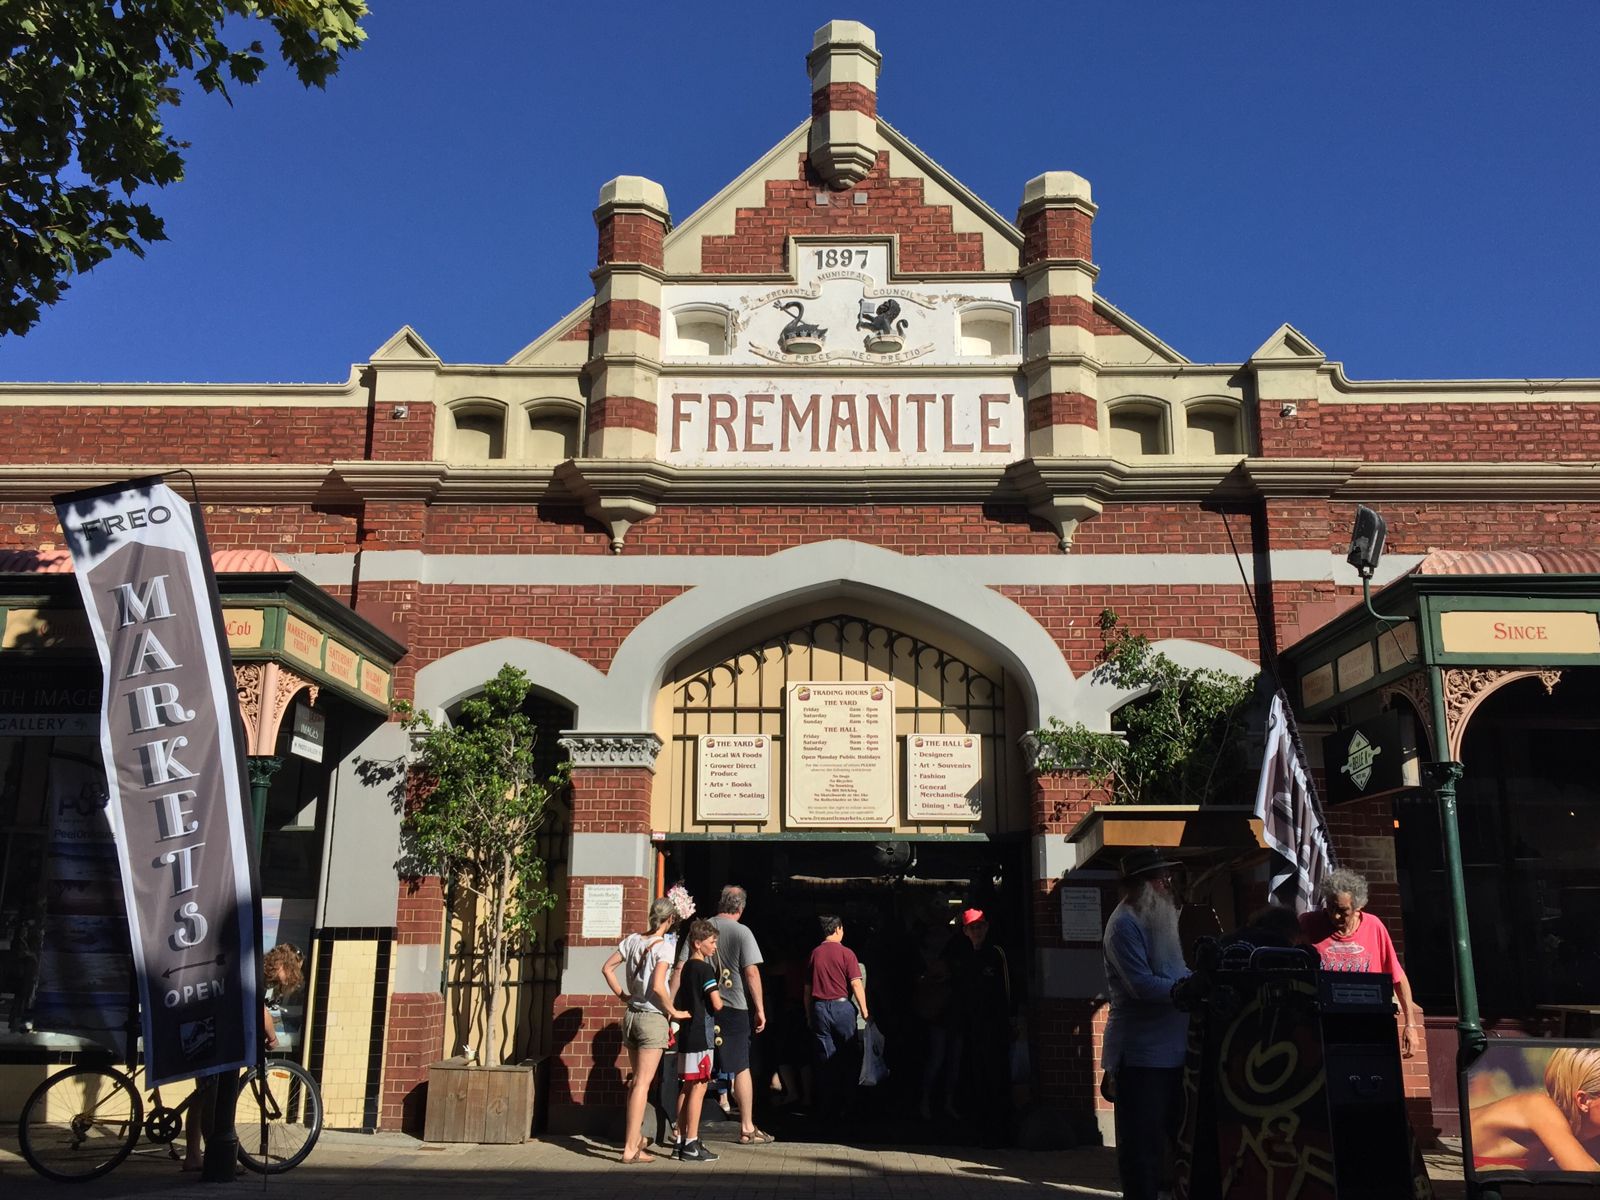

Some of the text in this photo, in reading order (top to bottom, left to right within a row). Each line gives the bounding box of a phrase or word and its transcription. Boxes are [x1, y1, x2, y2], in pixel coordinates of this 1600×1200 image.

[814, 248, 869, 269] 1897
[816, 270, 869, 283] MUNICIPAL
[765, 288, 818, 301] FREMANTLE
[872, 289, 915, 299] COUNCIL
[767, 349, 832, 362] NEC PRECE
[851, 348, 921, 362] NEC PRETIO
[670, 393, 1011, 453] FREMANTLE
[80, 505, 172, 542] FREO
[919, 751, 953, 759] Designers
[110, 574, 209, 952] MARKETS
[164, 977, 225, 1008] OPEN
